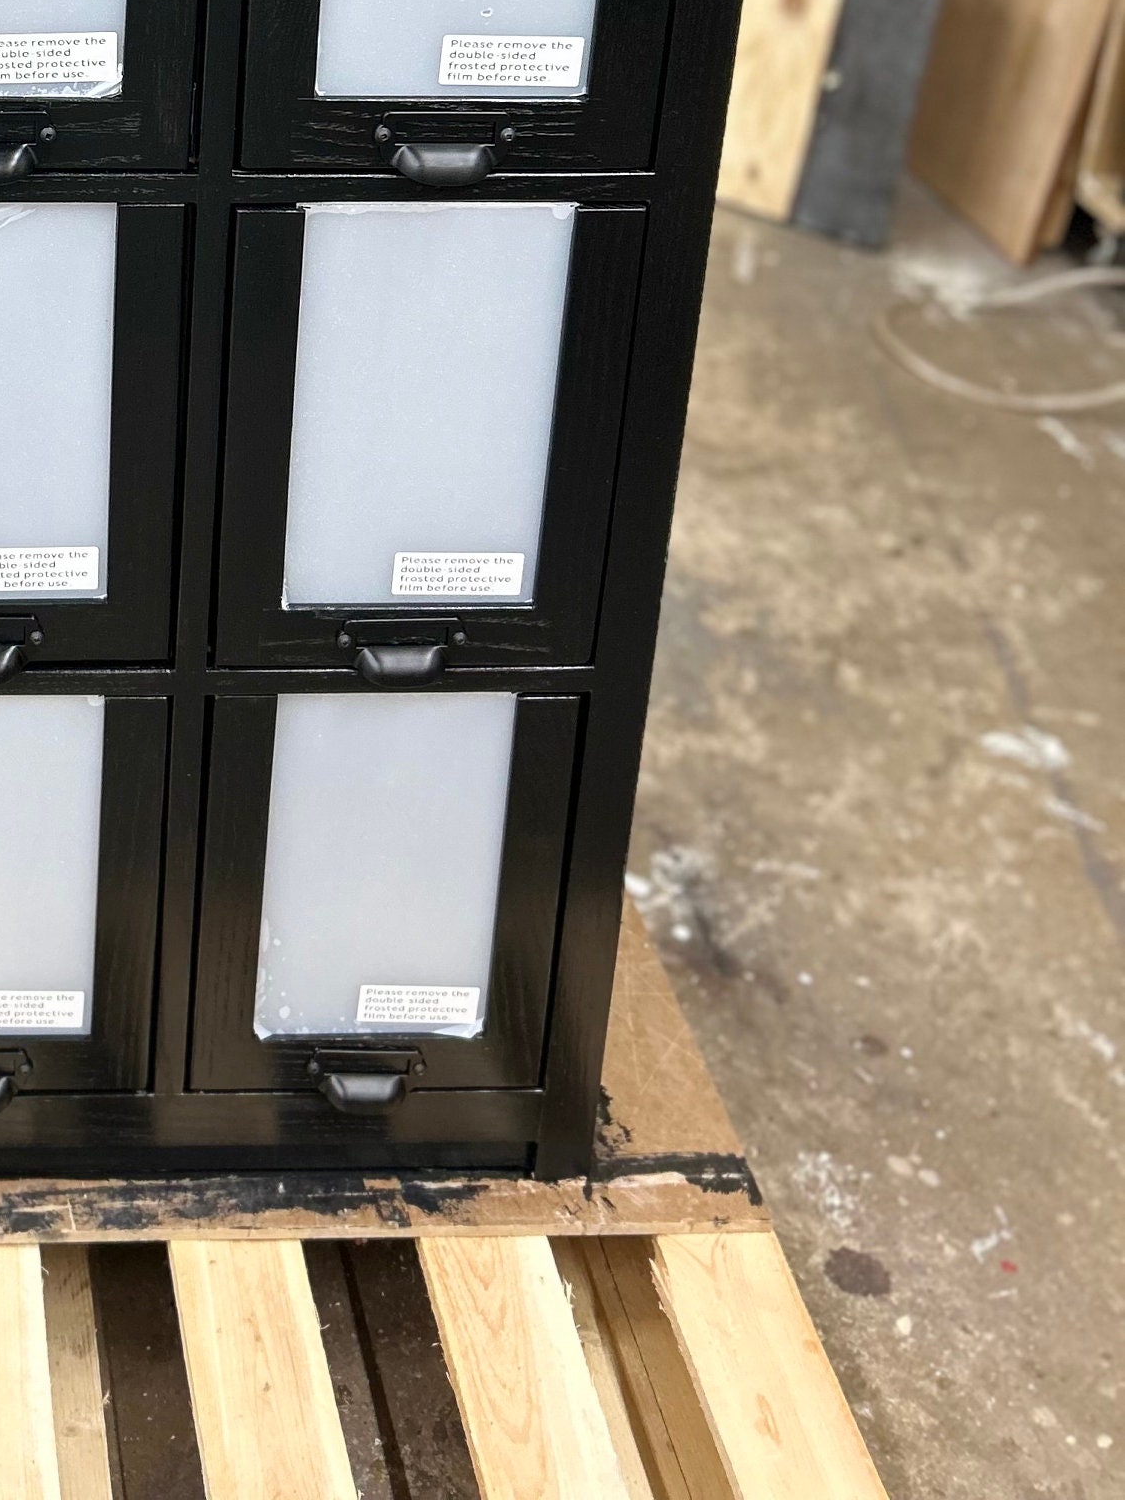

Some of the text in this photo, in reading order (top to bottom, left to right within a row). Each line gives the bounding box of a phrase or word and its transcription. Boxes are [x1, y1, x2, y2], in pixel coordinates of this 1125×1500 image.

[31, 38, 81, 47] remove
[84, 36, 107, 46] the
[450, 39, 573, 50] Please remove the
[36, 58, 107, 71] protective
[448, 60, 570, 73] frosted protective
[15, 70, 59, 80] before
[447, 72, 473, 81] film
[476, 72, 521, 82] before
[19, 552, 65, 560] remove
[68, 550, 89, 559] the
[401, 556, 442, 564] Please
[493, 556, 514, 565] the
[23, 569, 89, 580] protective
[399, 574, 512, 584] frosted protective
[3, 579, 45, 588] before
[399, 583, 423, 592] film
[426, 584, 467, 592] before
[366, 988, 404, 996] Please
[451, 990, 470, 998] the
[364, 1004, 406, 1012] frosted
[363, 1012, 386, 1020] film
[388, 1012, 427, 1021] before
